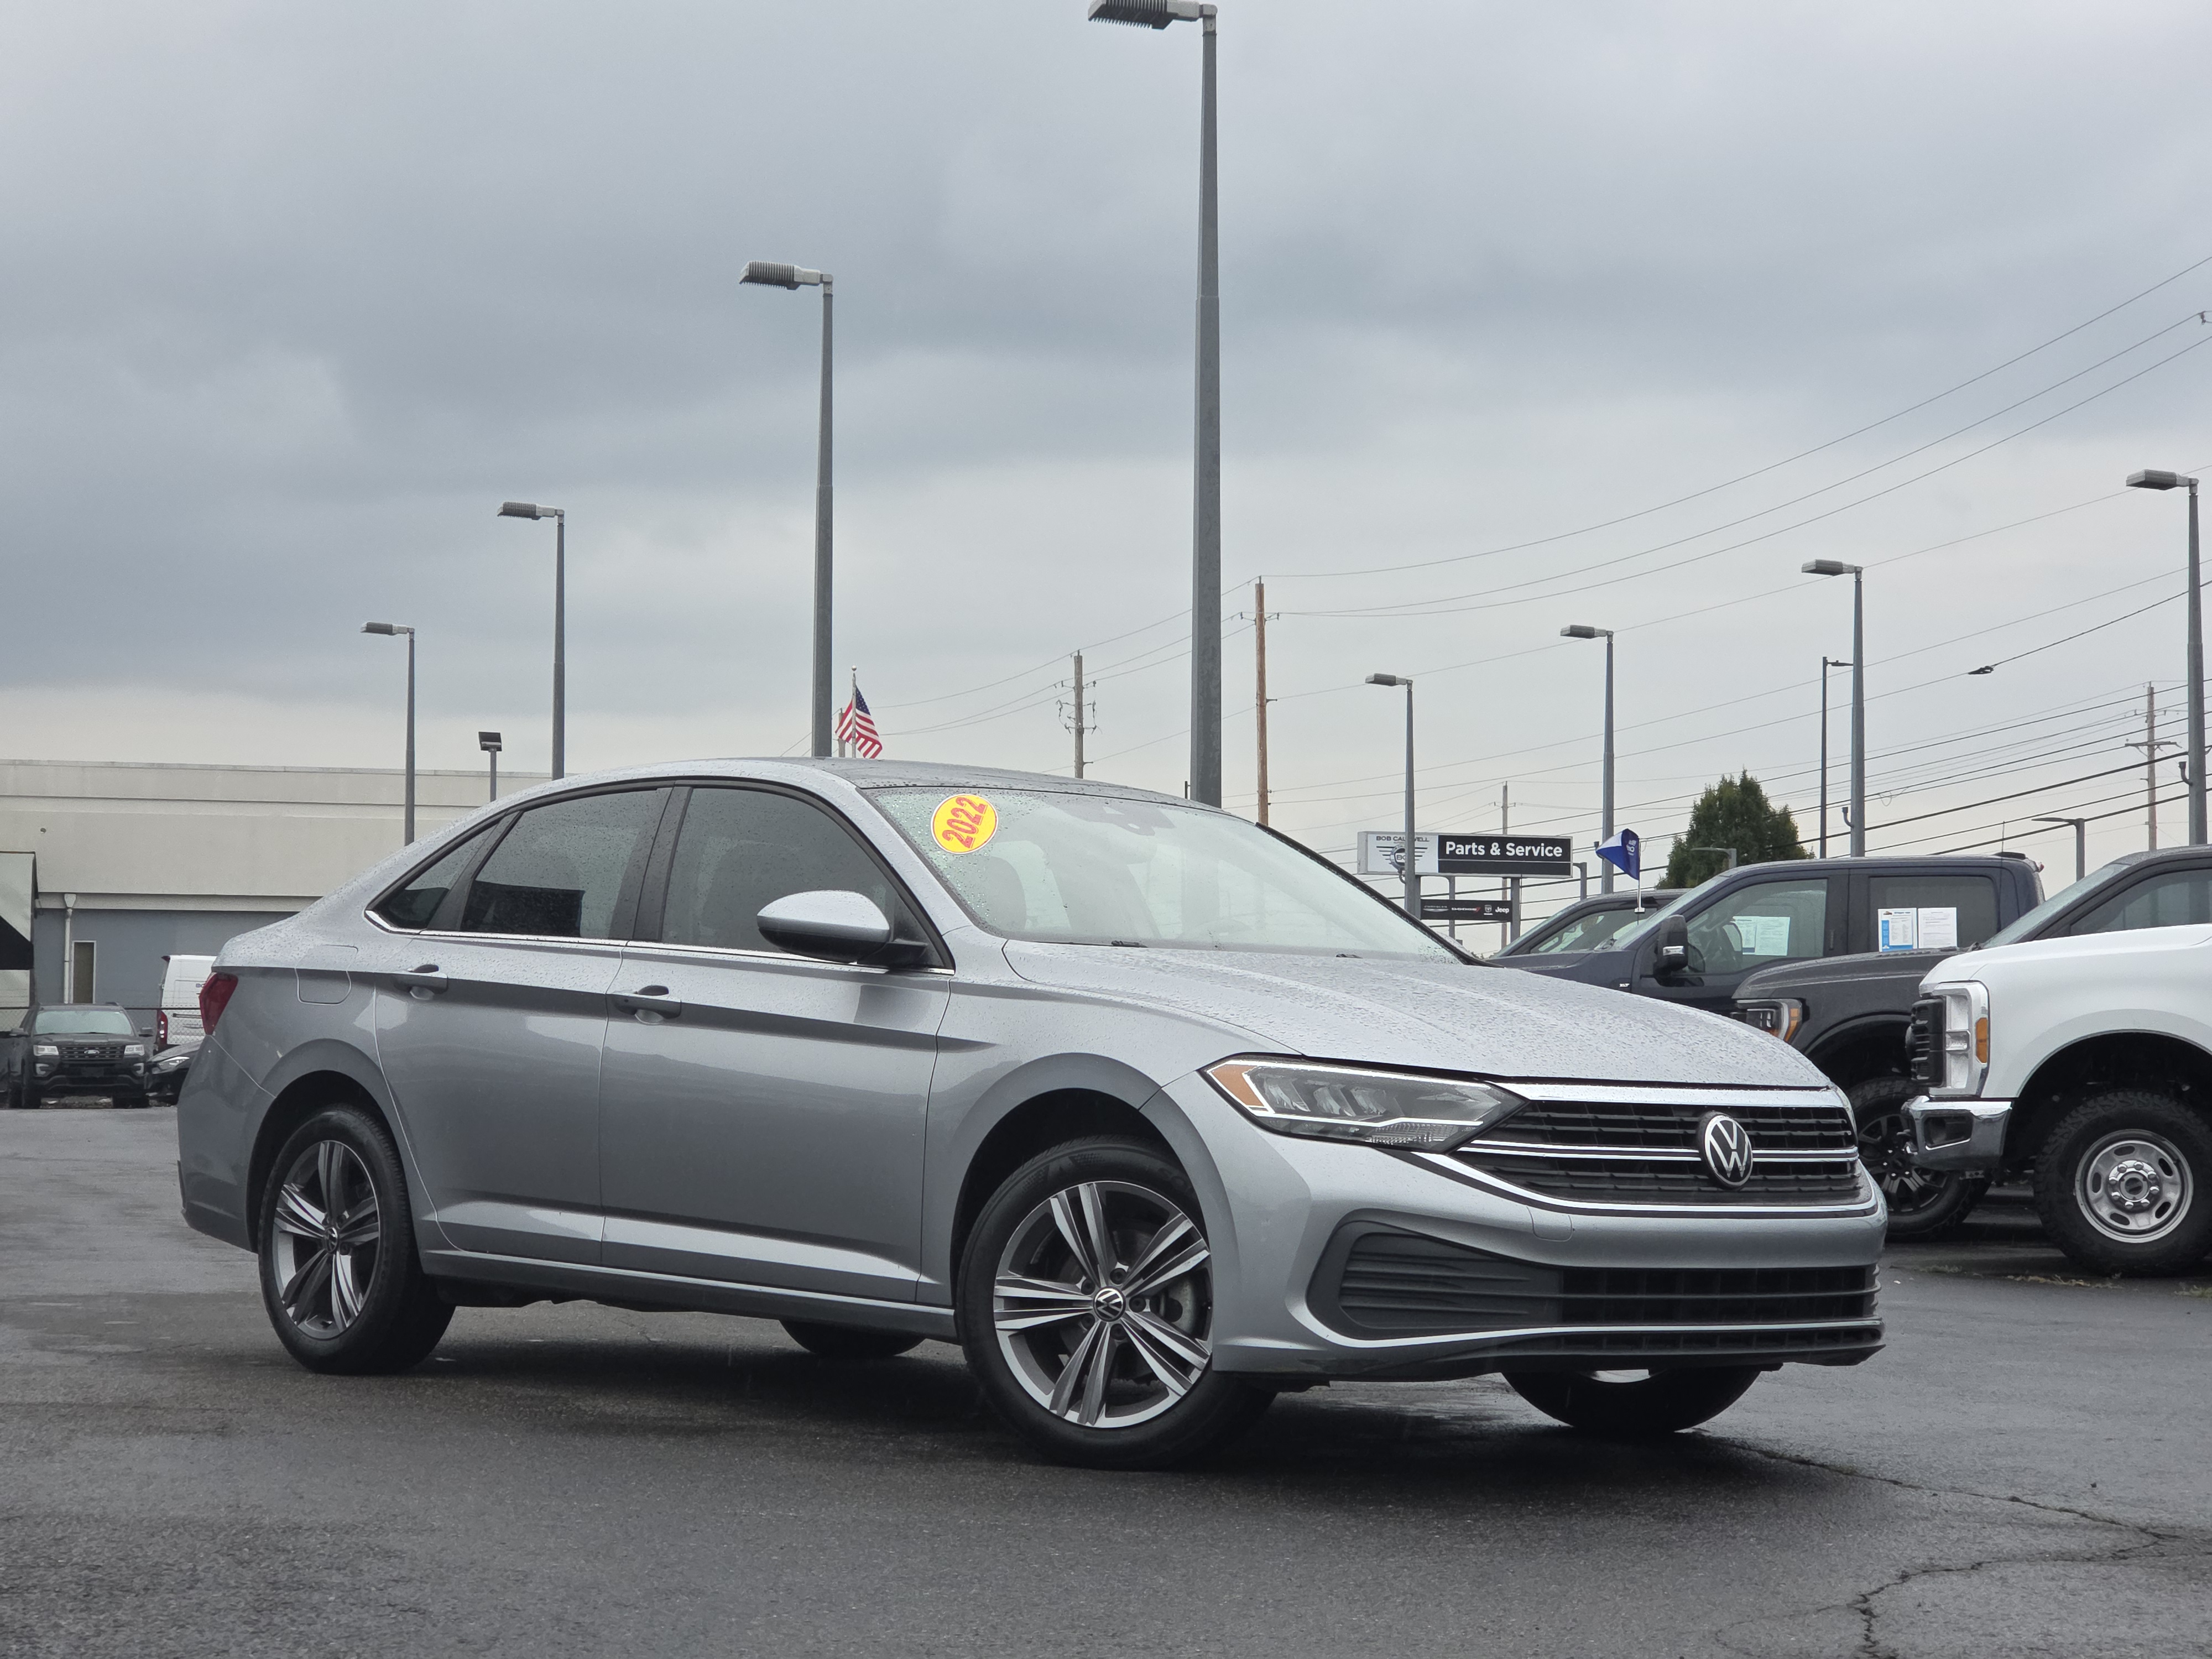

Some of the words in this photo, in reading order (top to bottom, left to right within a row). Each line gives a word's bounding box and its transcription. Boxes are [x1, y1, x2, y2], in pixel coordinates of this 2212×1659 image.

[942, 797, 988, 849] 2022
[1446, 841, 1485, 855] Parts
[1490, 842, 1501, 855] &
[1506, 842, 1563, 857] Service
